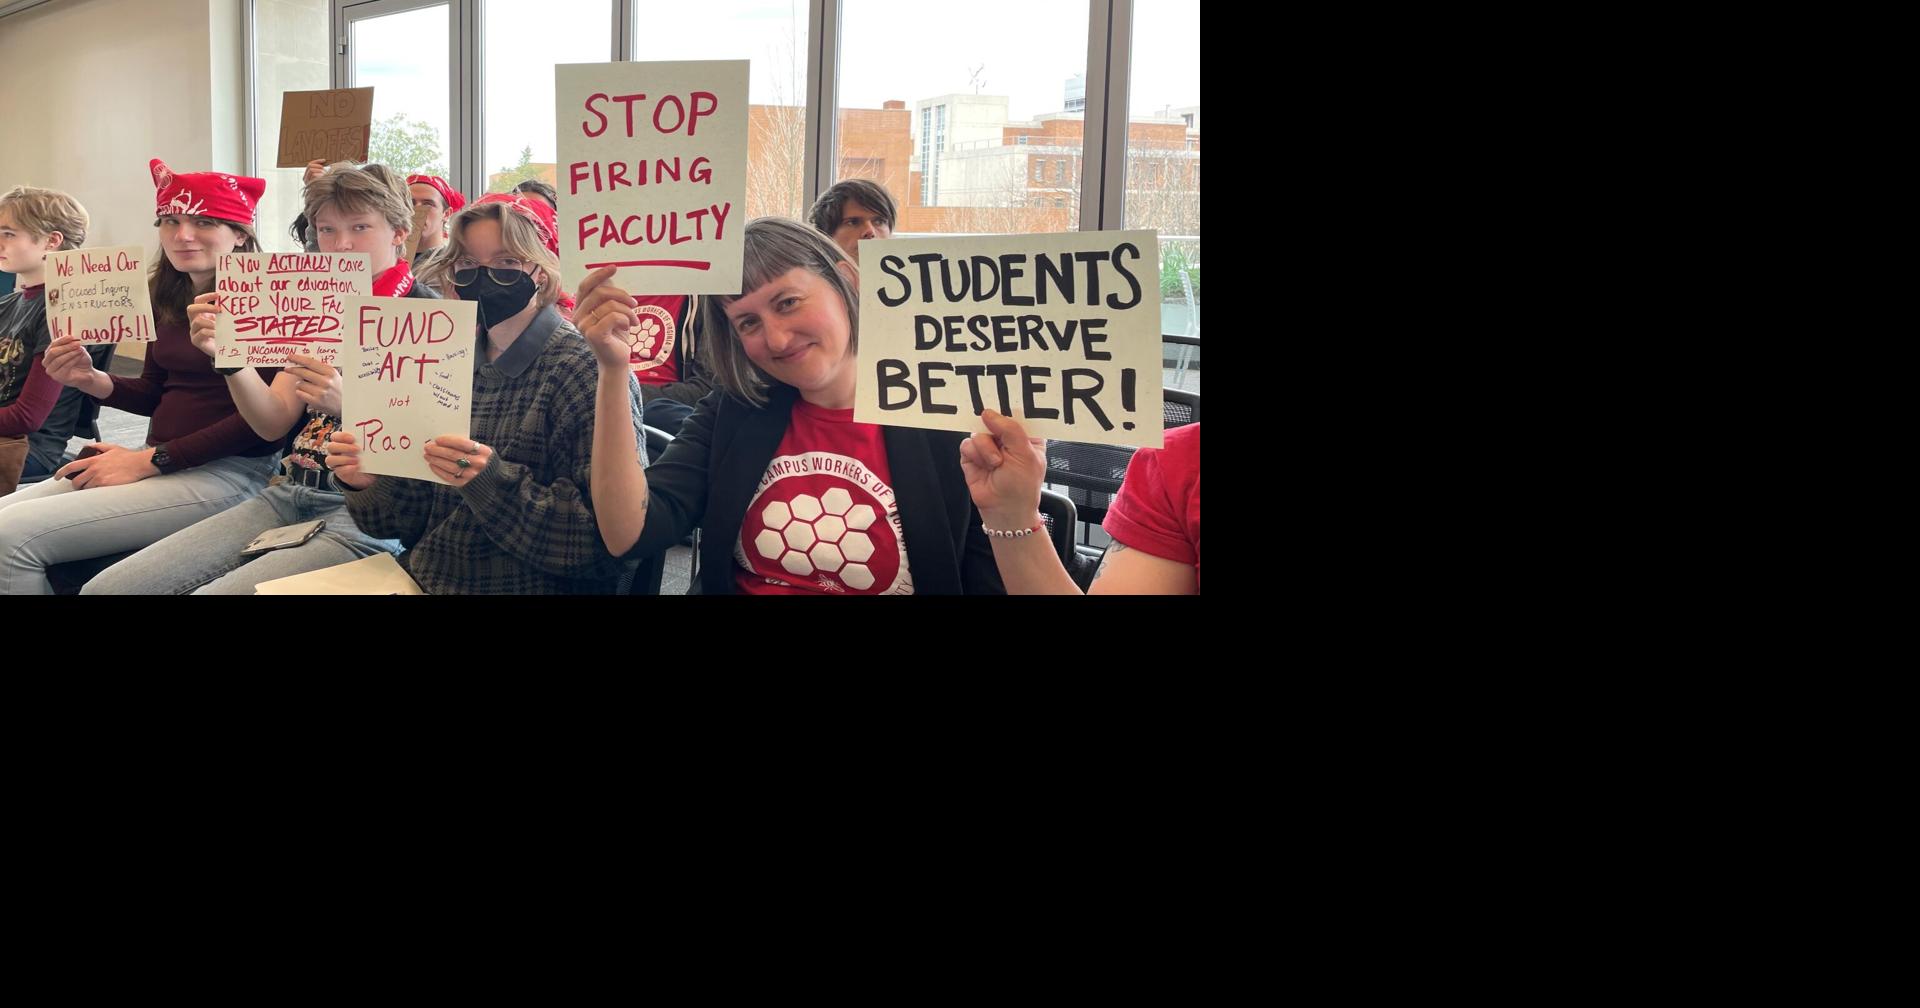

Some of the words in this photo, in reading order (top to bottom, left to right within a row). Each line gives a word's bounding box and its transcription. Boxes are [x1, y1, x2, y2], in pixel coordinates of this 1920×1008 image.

[310, 91, 356, 119] NO
[583, 92, 718, 137] STOP
[570, 157, 712, 195] FIRING
[578, 202, 731, 250] FACULTY
[56, 256, 74, 276] We
[82, 254, 111, 274] Need
[117, 252, 140, 271] Our
[220, 256, 232, 272] If
[267, 254, 332, 273] ACTUALLY
[338, 258, 366, 272] care
[877, 242, 1142, 310] STUDENTS
[61, 282, 96, 301] Focused
[100, 279, 130, 297] Inquiry
[218, 276, 264, 292] about
[270, 279, 291, 291] our
[297, 277, 361, 295] education,
[218, 296, 260, 316] KEEP
[269, 292, 315, 315] YOUR
[322, 295, 344, 315] FAC
[360, 306, 454, 347] FUND
[914, 314, 1112, 360] DESERVE
[246, 356, 289, 365] Professor
[248, 346, 298, 355] UNCOMMON
[316, 346, 338, 354] learn
[378, 352, 440, 384] Art
[876, 359, 1136, 431] BETTER!
[355, 419, 411, 454] Rao
[760, 458, 808, 486] CAMPUS
[812, 457, 872, 485] WORKERS
[872, 482, 892, 498] OF
